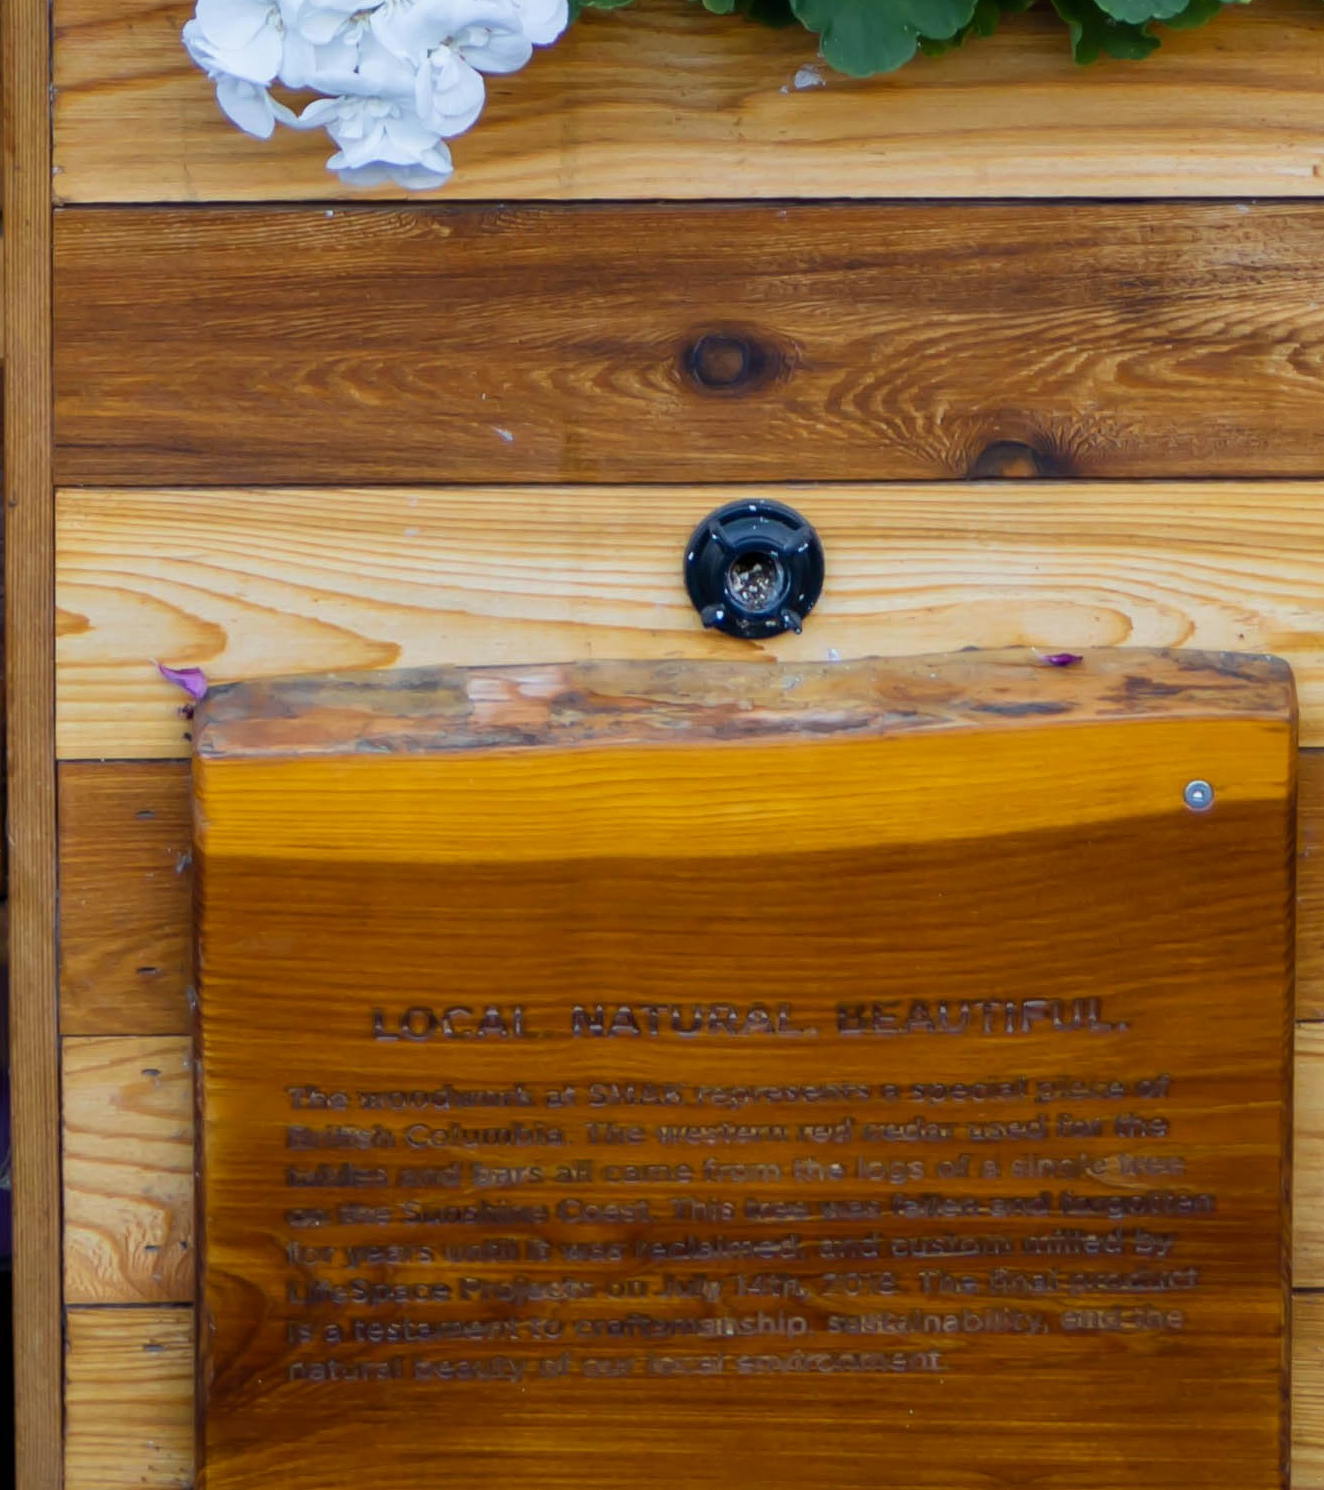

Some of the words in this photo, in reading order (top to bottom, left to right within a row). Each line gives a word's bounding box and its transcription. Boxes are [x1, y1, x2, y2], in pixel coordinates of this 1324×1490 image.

[573, 1002, 818, 1039] NATURAL.
[836, 997, 1131, 1037] BEAUTIFUL.
[288, 1084, 349, 1111] The
[360, 1083, 533, 1110] woodwork
[546, 1085, 576, 1108] at
[698, 1083, 871, 1111] represents
[881, 1083, 900, 1100] a
[912, 1078, 1029, 1106] special
[1035, 1078, 1125, 1105] piece
[1136, 1072, 1172, 1099] of
[287, 1123, 395, 1149] British
[404, 1122, 572, 1148] Columbia.
[585, 1122, 647, 1146] The
[657, 1123, 789, 1145] western
[798, 1116, 855, 1142] red
[863, 1115, 955, 1142] cedar
[967, 1114, 1050, 1140] used
[1056, 1113, 1105, 1138] for
[1114, 1111, 1171, 1139] the
[396, 1162, 462, 1187] and
[473, 1161, 544, 1187] bars
[554, 1160, 592, 1184] all
[603, 1162, 692, 1184] came
[703, 1158, 782, 1183] from
[792, 1158, 846, 1182] the
[857, 1157, 925, 1185] logs
[936, 1155, 972, 1179] of
[980, 1159, 1001, 1179] a
[1010, 1155, 1109, 1183] single
[1117, 1154, 1186, 1179] tree
[284, 1205, 331, 1227] on
[337, 1201, 394, 1226] the
[396, 1198, 549, 1226] Sunshine
[556, 1198, 661, 1224] Coast.
[668, 1196, 735, 1224] This
[743, 1197, 809, 1221] tree
[820, 1200, 883, 1220] was
[989, 1190, 1052, 1218] and
[1059, 1188, 1216, 1221] forgotten
[286, 1240, 343, 1265] for
[347, 1242, 436, 1270] years
[445, 1238, 518, 1263] until
[525, 1237, 552, 1262] it
[562, 1241, 624, 1262] was
[818, 1232, 880, 1259] and
[891, 1233, 1013, 1258] custom
[1021, 1229, 1125, 1255] milled
[1134, 1229, 1174, 1258] by
[288, 1277, 452, 1307] LifeSpace
[458, 1275, 596, 1305] Projects
[605, 1277, 647, 1299] on
[651, 1272, 723, 1303] July
[736, 1271, 810, 1301] 14th,
[918, 1268, 978, 1294] The
[988, 1265, 1061, 1293] final
[1068, 1266, 1200, 1297] product
[288, 1319, 312, 1344] is
[323, 1323, 343, 1344] a
[354, 1317, 521, 1343] testament
[528, 1315, 565, 1340] to
[827, 1307, 1051, 1337] sustainability,
[1061, 1305, 1124, 1330] and
[1129, 1304, 1185, 1330] the
[288, 1357, 404, 1382] natural
[413, 1353, 525, 1385] beauty
[539, 1351, 572, 1379] of
[582, 1356, 636, 1378] our
[647, 1353, 725, 1377] local
